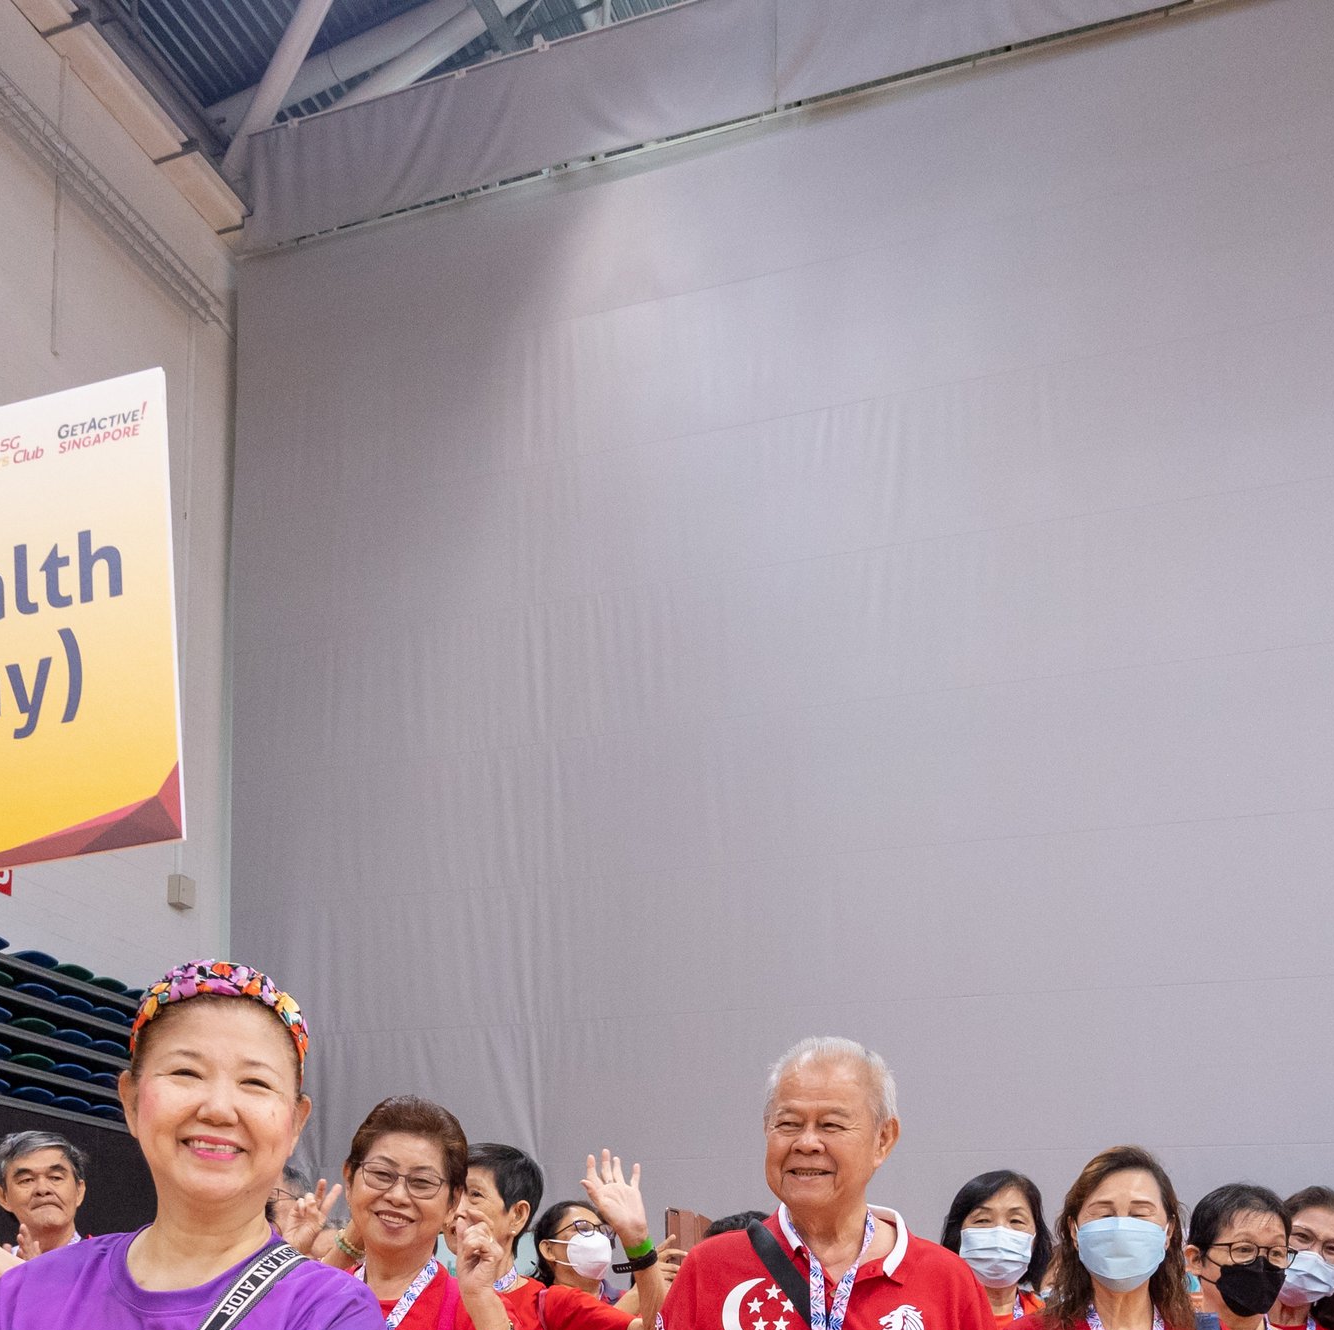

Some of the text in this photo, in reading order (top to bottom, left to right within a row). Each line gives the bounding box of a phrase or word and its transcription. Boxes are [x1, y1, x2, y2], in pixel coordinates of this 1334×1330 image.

[58, 424, 140, 454] SINGAPORE
[13, 446, 44, 464] Club
[220, 1280, 257, 1316] AIOR
